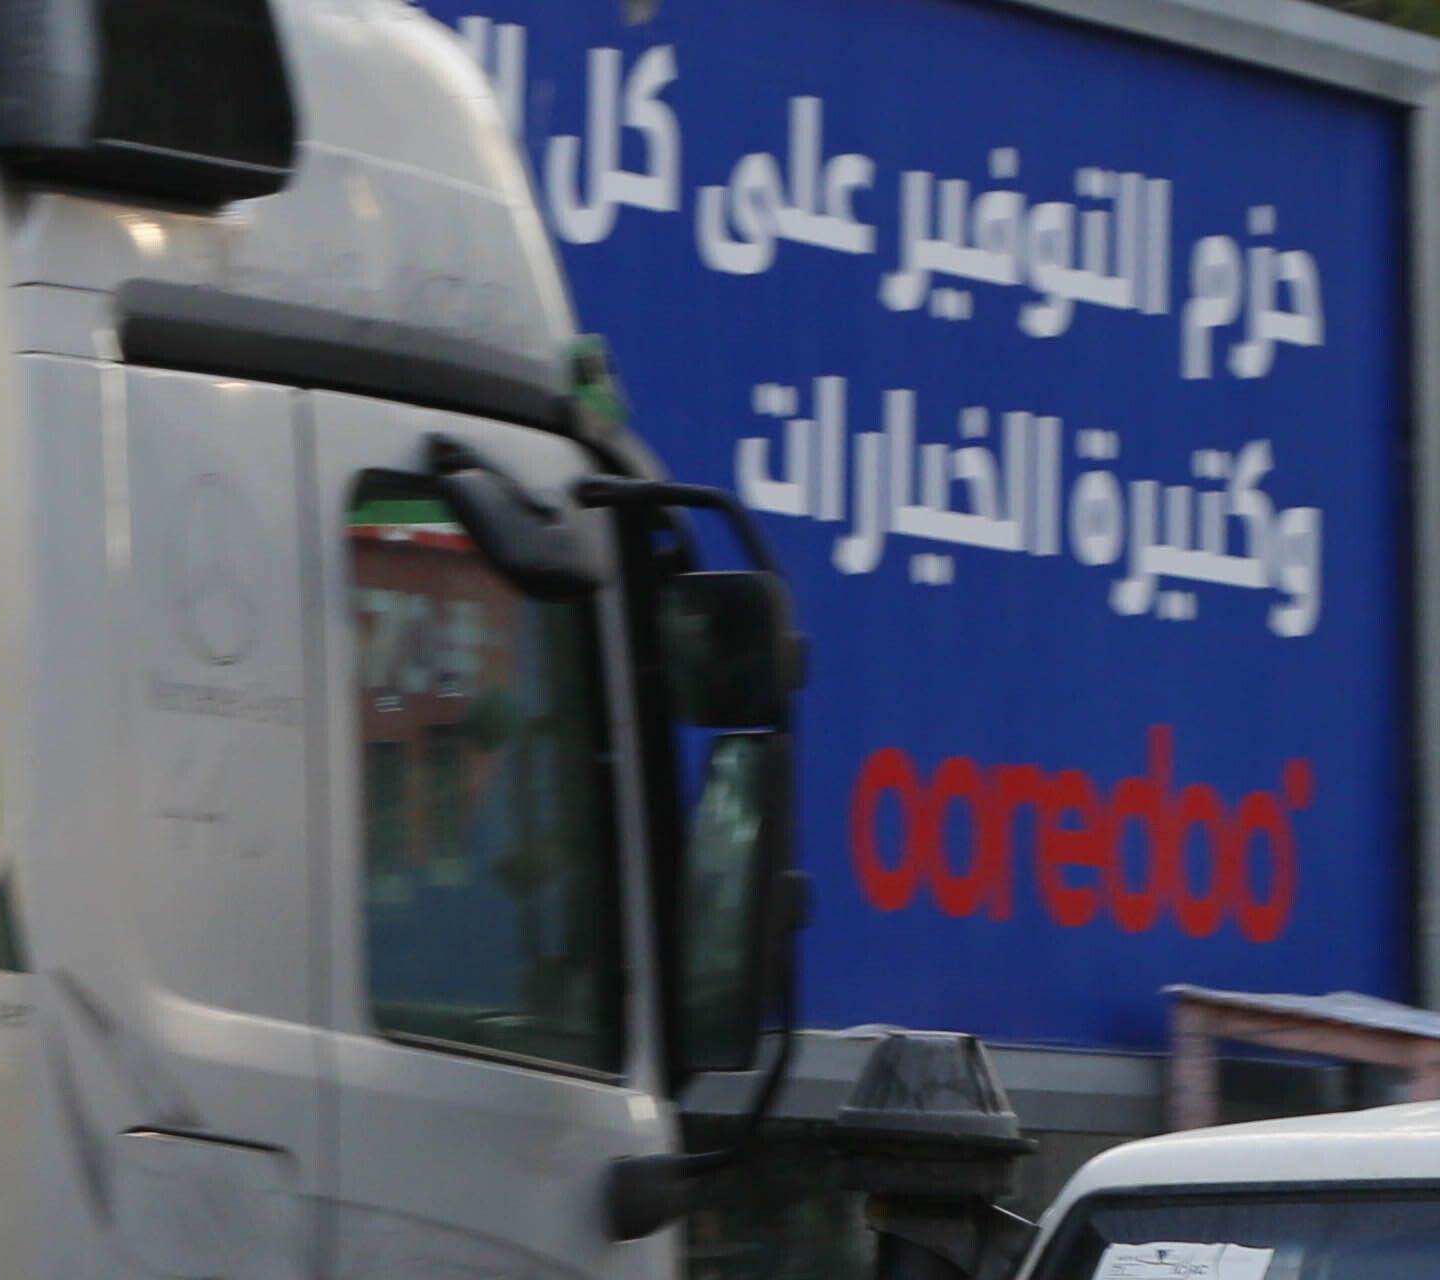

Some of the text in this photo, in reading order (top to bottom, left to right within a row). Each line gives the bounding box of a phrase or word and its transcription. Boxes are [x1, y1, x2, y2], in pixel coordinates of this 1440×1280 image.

[543, 44, 682, 244] كل
[695, 95, 876, 276] على
[878, 145, 1171, 338] التوفير
[1180, 204, 1325, 380] حزم
[734, 375, 1064, 587] الخيارات
[850, 723, 1300, 943] ooredoo
